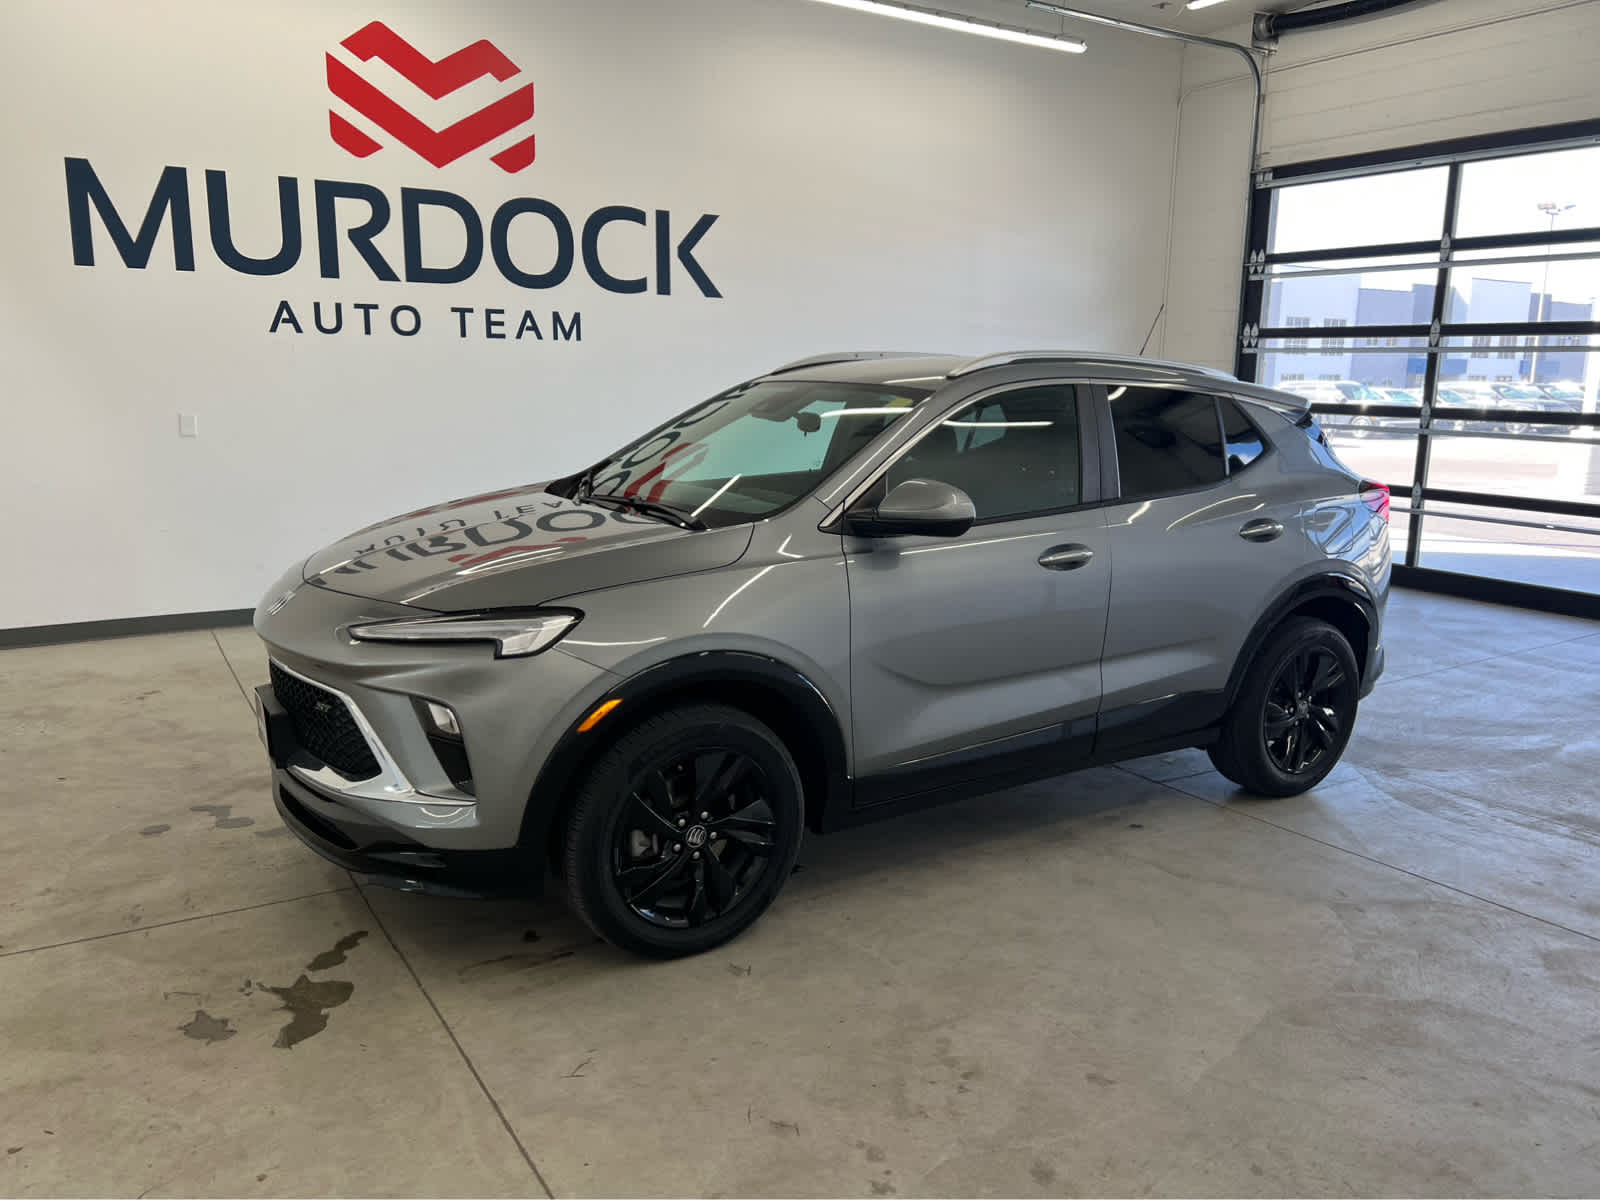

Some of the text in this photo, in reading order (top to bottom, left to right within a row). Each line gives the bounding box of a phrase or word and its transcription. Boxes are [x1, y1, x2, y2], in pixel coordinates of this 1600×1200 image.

[64, 156, 723, 299] MURDOCK
[270, 300, 583, 342] AUTO TEAM
